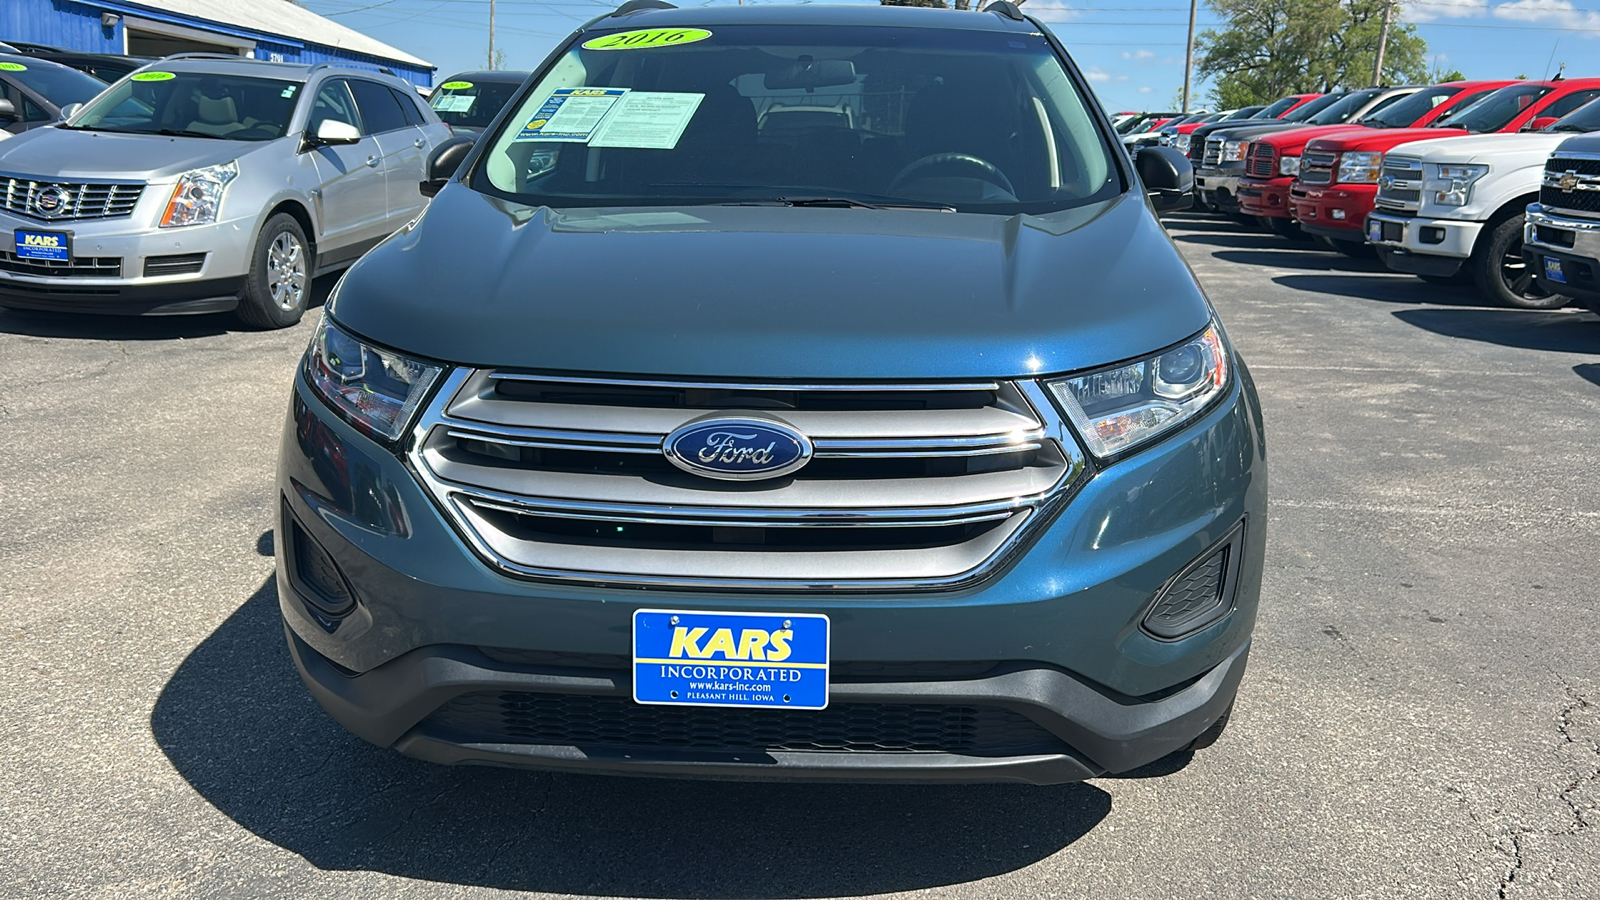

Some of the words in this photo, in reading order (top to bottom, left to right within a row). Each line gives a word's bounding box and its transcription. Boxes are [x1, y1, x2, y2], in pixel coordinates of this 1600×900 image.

[599, 30, 692, 48] 2016
[25, 234, 59, 247] KARS
[698, 431, 776, 464] Ford
[668, 626, 794, 662] KARS
[660, 665, 802, 683] INCORPORATED
[687, 692, 726, 700] PLEASANT
